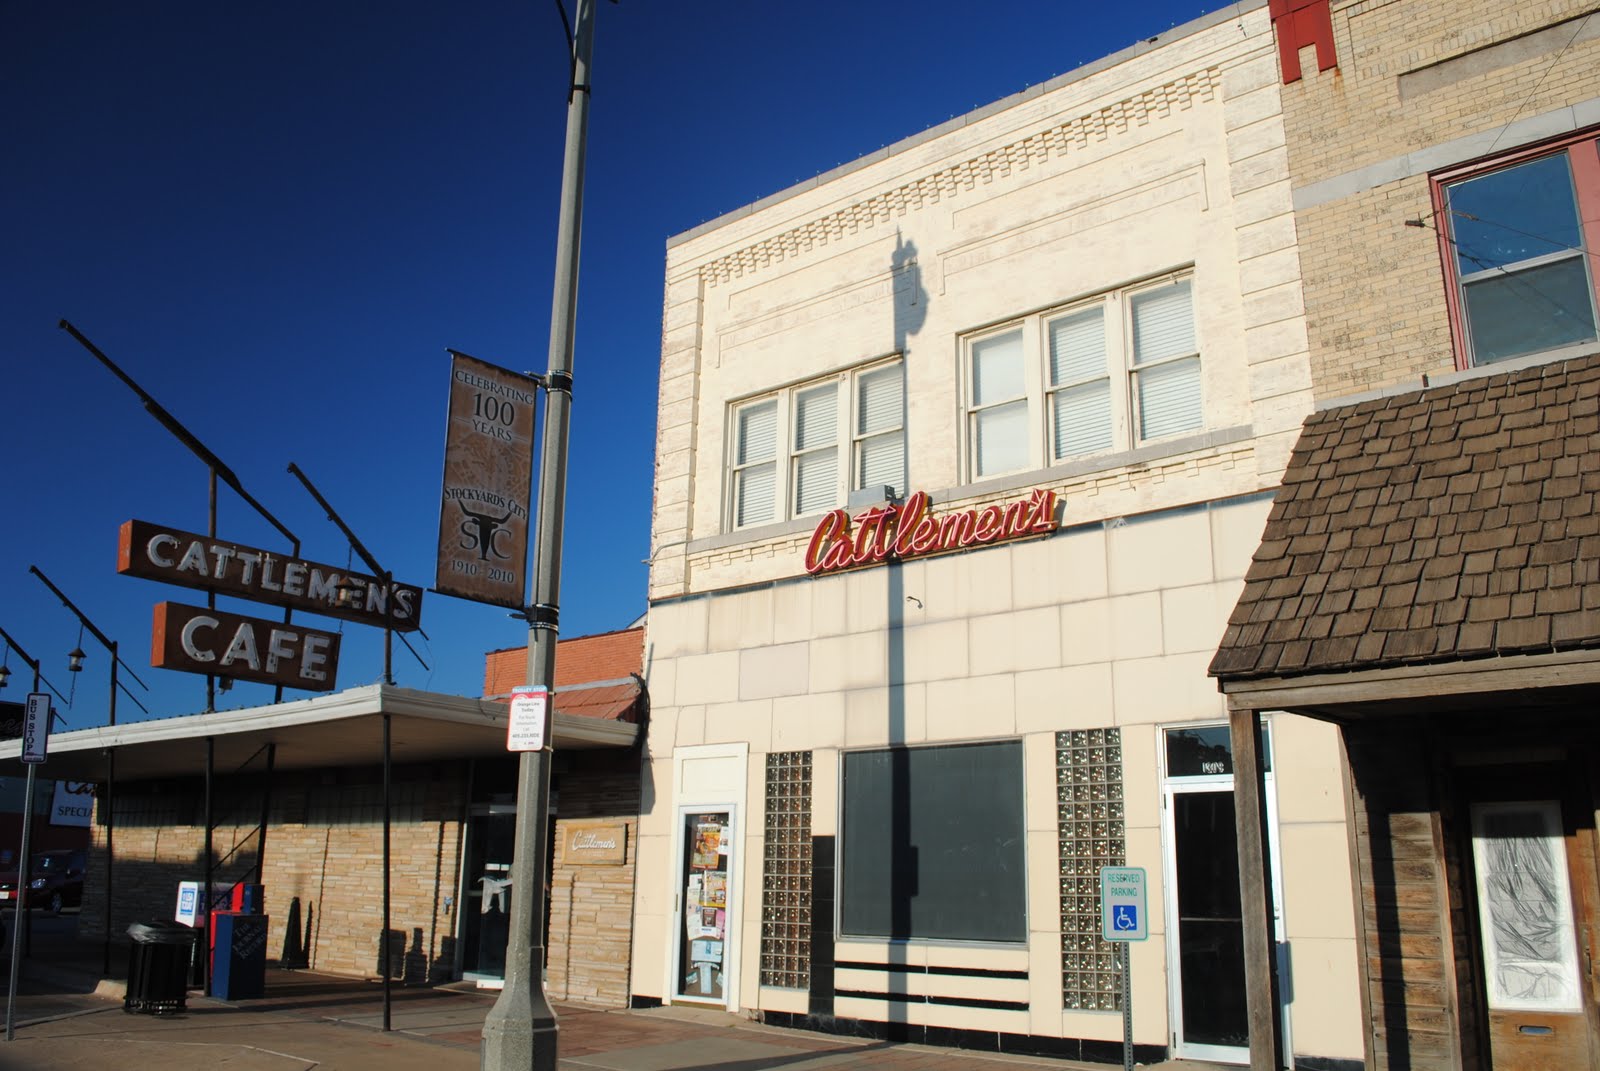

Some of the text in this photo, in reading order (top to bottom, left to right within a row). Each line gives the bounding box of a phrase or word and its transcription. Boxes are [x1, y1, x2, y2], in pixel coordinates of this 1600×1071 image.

[455, 370, 534, 405] CELEBRATING
[474, 393, 515, 426] 100
[472, 420, 513, 441] YEARS
[445, 486, 505, 508] STOCKYARDS
[804, 488, 1059, 575] Cattlemen's
[147, 533, 417, 619] CATTLEMEN'S
[451, 560, 477, 575] 1910
[488, 567, 514, 583] 2010
[180, 615, 331, 681] CAFE
[29, 699, 38, 720] BUS
[26, 722, 35, 751] STOP
[1107, 873, 1140, 883] RESERVED
[1110, 887, 1138, 897] PARKING
